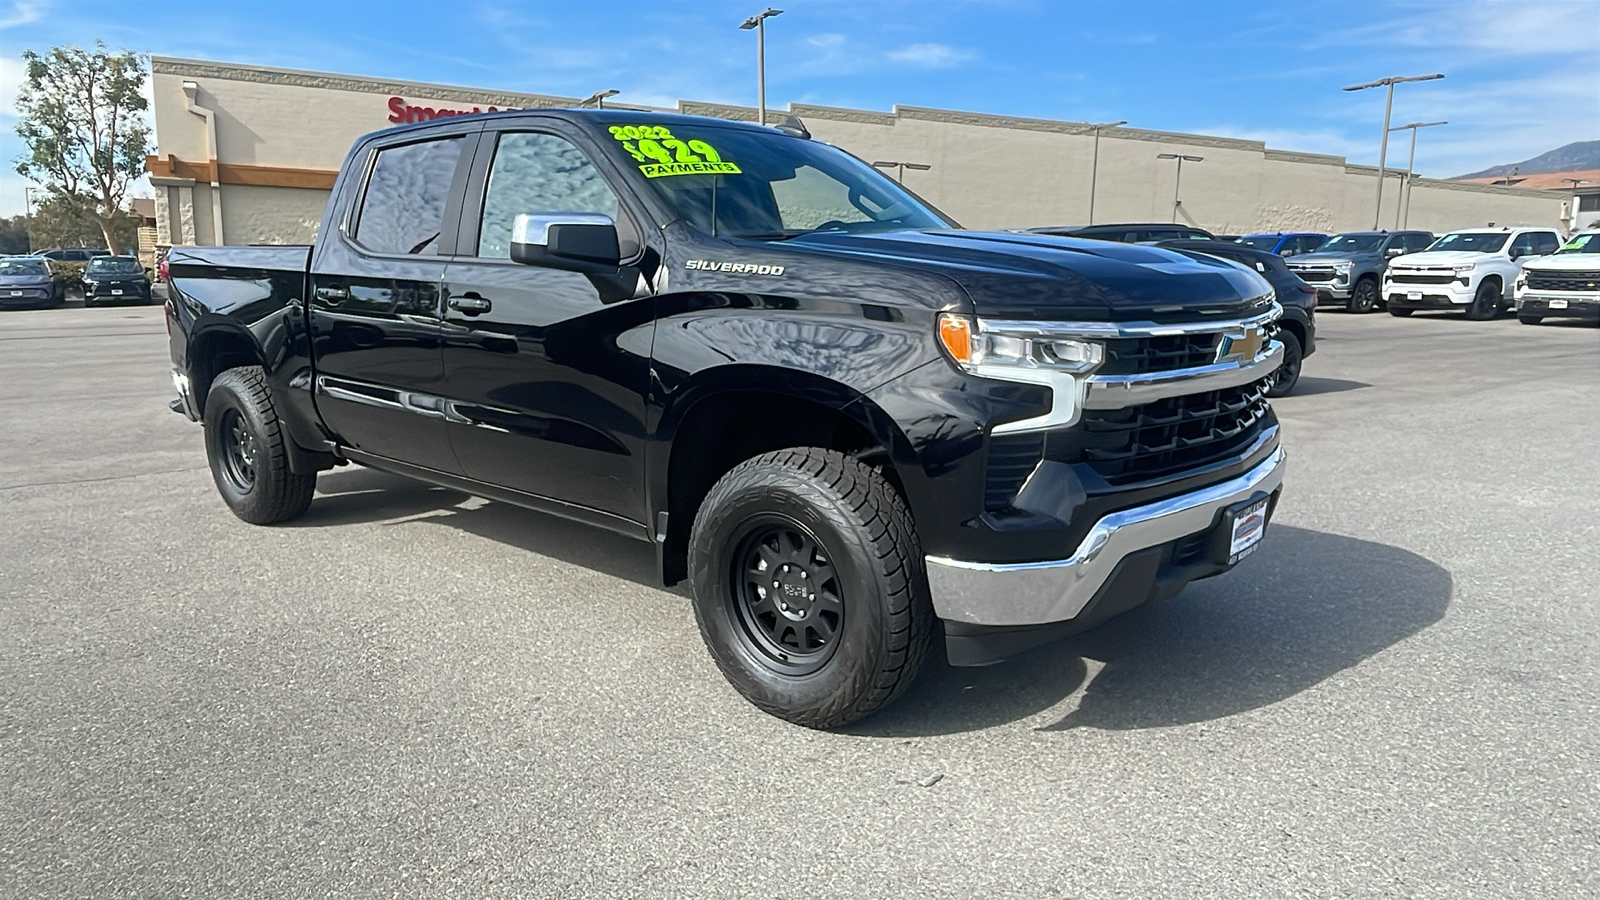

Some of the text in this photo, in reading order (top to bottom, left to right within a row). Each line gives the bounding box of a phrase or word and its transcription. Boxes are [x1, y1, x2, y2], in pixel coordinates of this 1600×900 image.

[608, 125, 675, 140] 2022
[643, 163, 735, 175] PAYMENTS
[685, 259, 785, 276] SILVERADO
